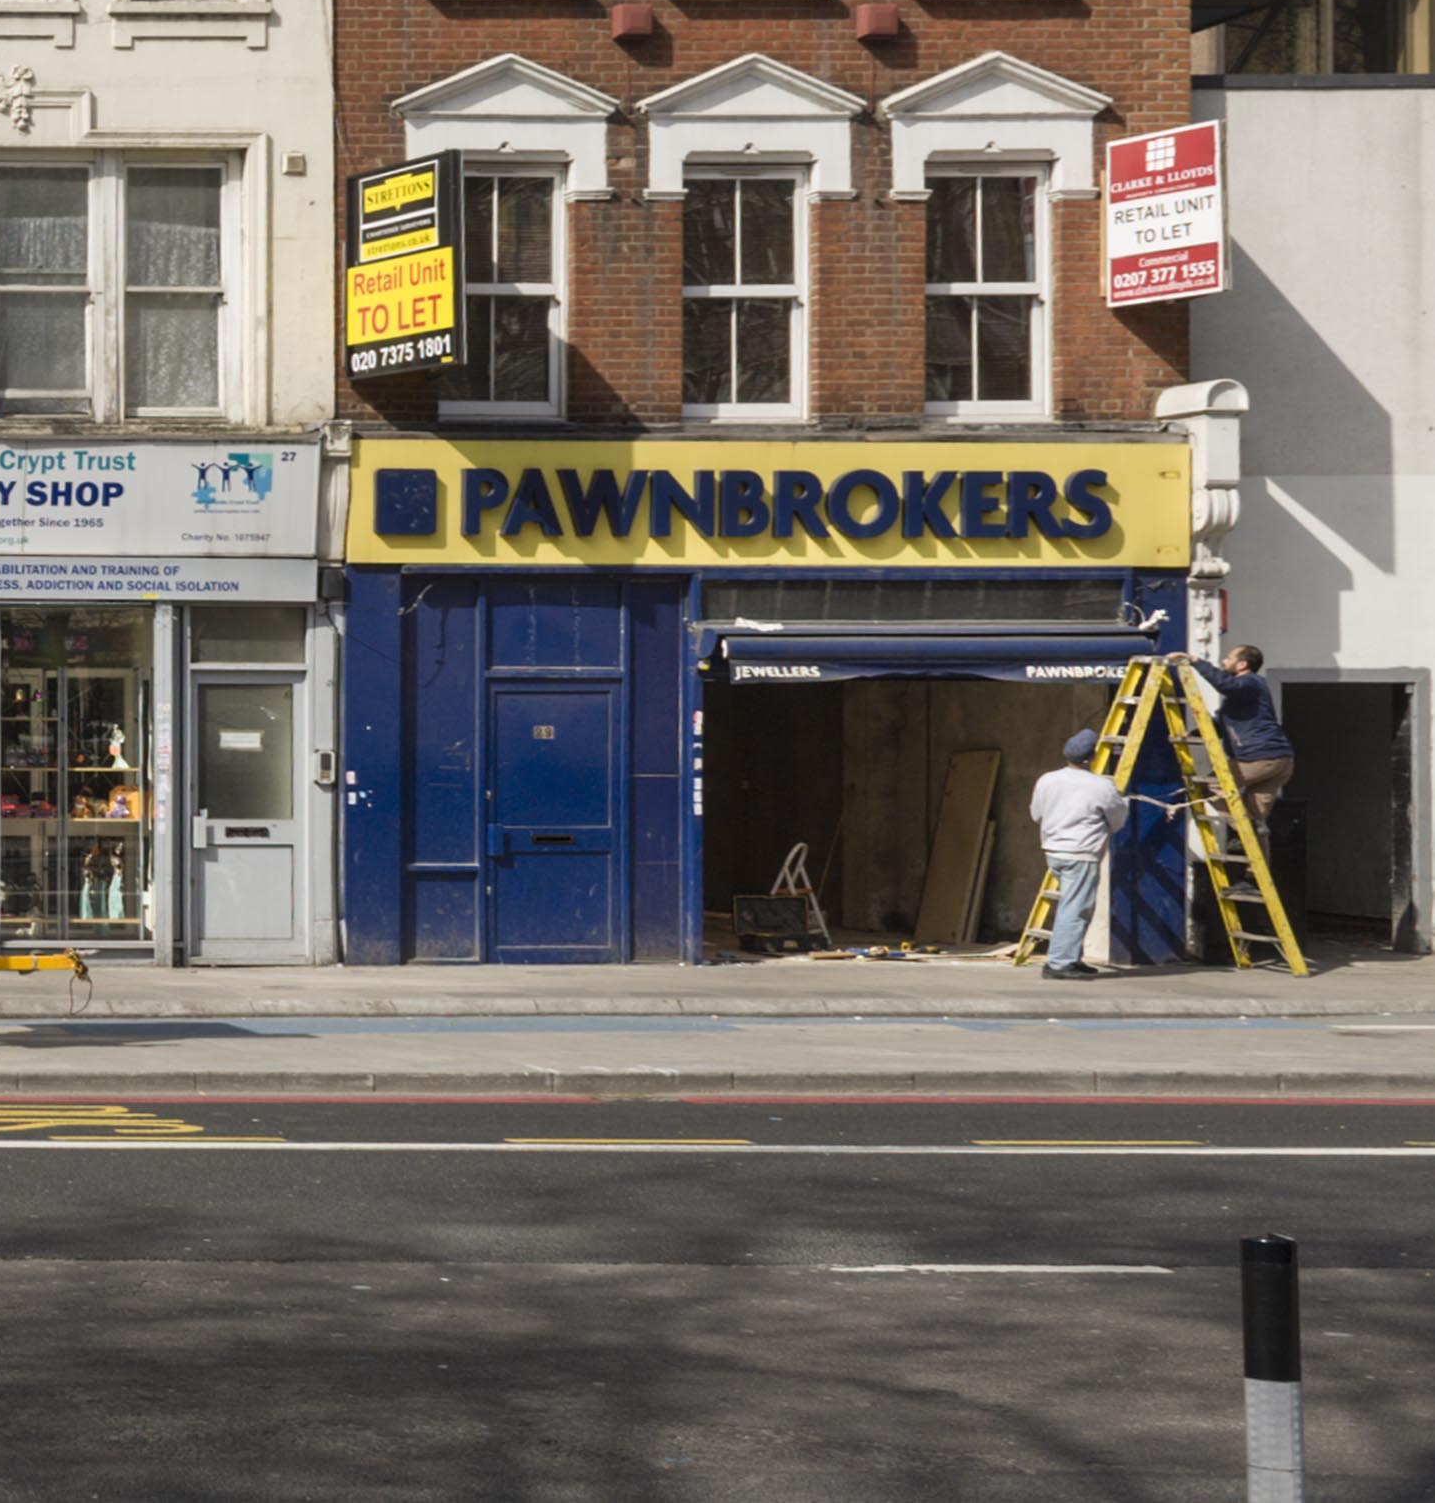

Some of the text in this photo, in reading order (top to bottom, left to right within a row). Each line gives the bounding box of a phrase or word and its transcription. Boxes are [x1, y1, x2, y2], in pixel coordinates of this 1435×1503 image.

[1111, 165, 1214, 193] CLARKE & LLOYDS
[367, 181, 431, 205] STRETTONS
[1114, 195, 1214, 225] RETAIL UNIT
[1135, 222, 1193, 244] TO LET
[354, 258, 446, 297] Retail Unit
[1114, 259, 1216, 289] 0207 377 1555
[357, 294, 443, 336] TO LET
[351, 334, 451, 372] 020 7375 1801
[0, 450, 66, 474] Crypt
[73, 451, 136, 471] Trust
[281, 452, 296, 462] 27
[25, 481, 124, 507] SHOP
[460, 468, 1112, 539] PAWNBROKERS
[39, 517, 70, 528] Since
[74, 518, 104, 528] 1965
[181, 533, 213, 542] Charity
[71, 565, 97, 575] AND
[101, 565, 159, 576] TRAINING
[163, 566, 180, 576] OF
[26, 580, 93, 590] ADDICTION
[97, 581, 123, 591] AND
[127, 581, 171, 591] SOCIAL
[176, 581, 239, 592] ISOLATION
[734, 665, 821, 680] JEWELLERS
[1025, 665, 1130, 679] PAWNBROKE
